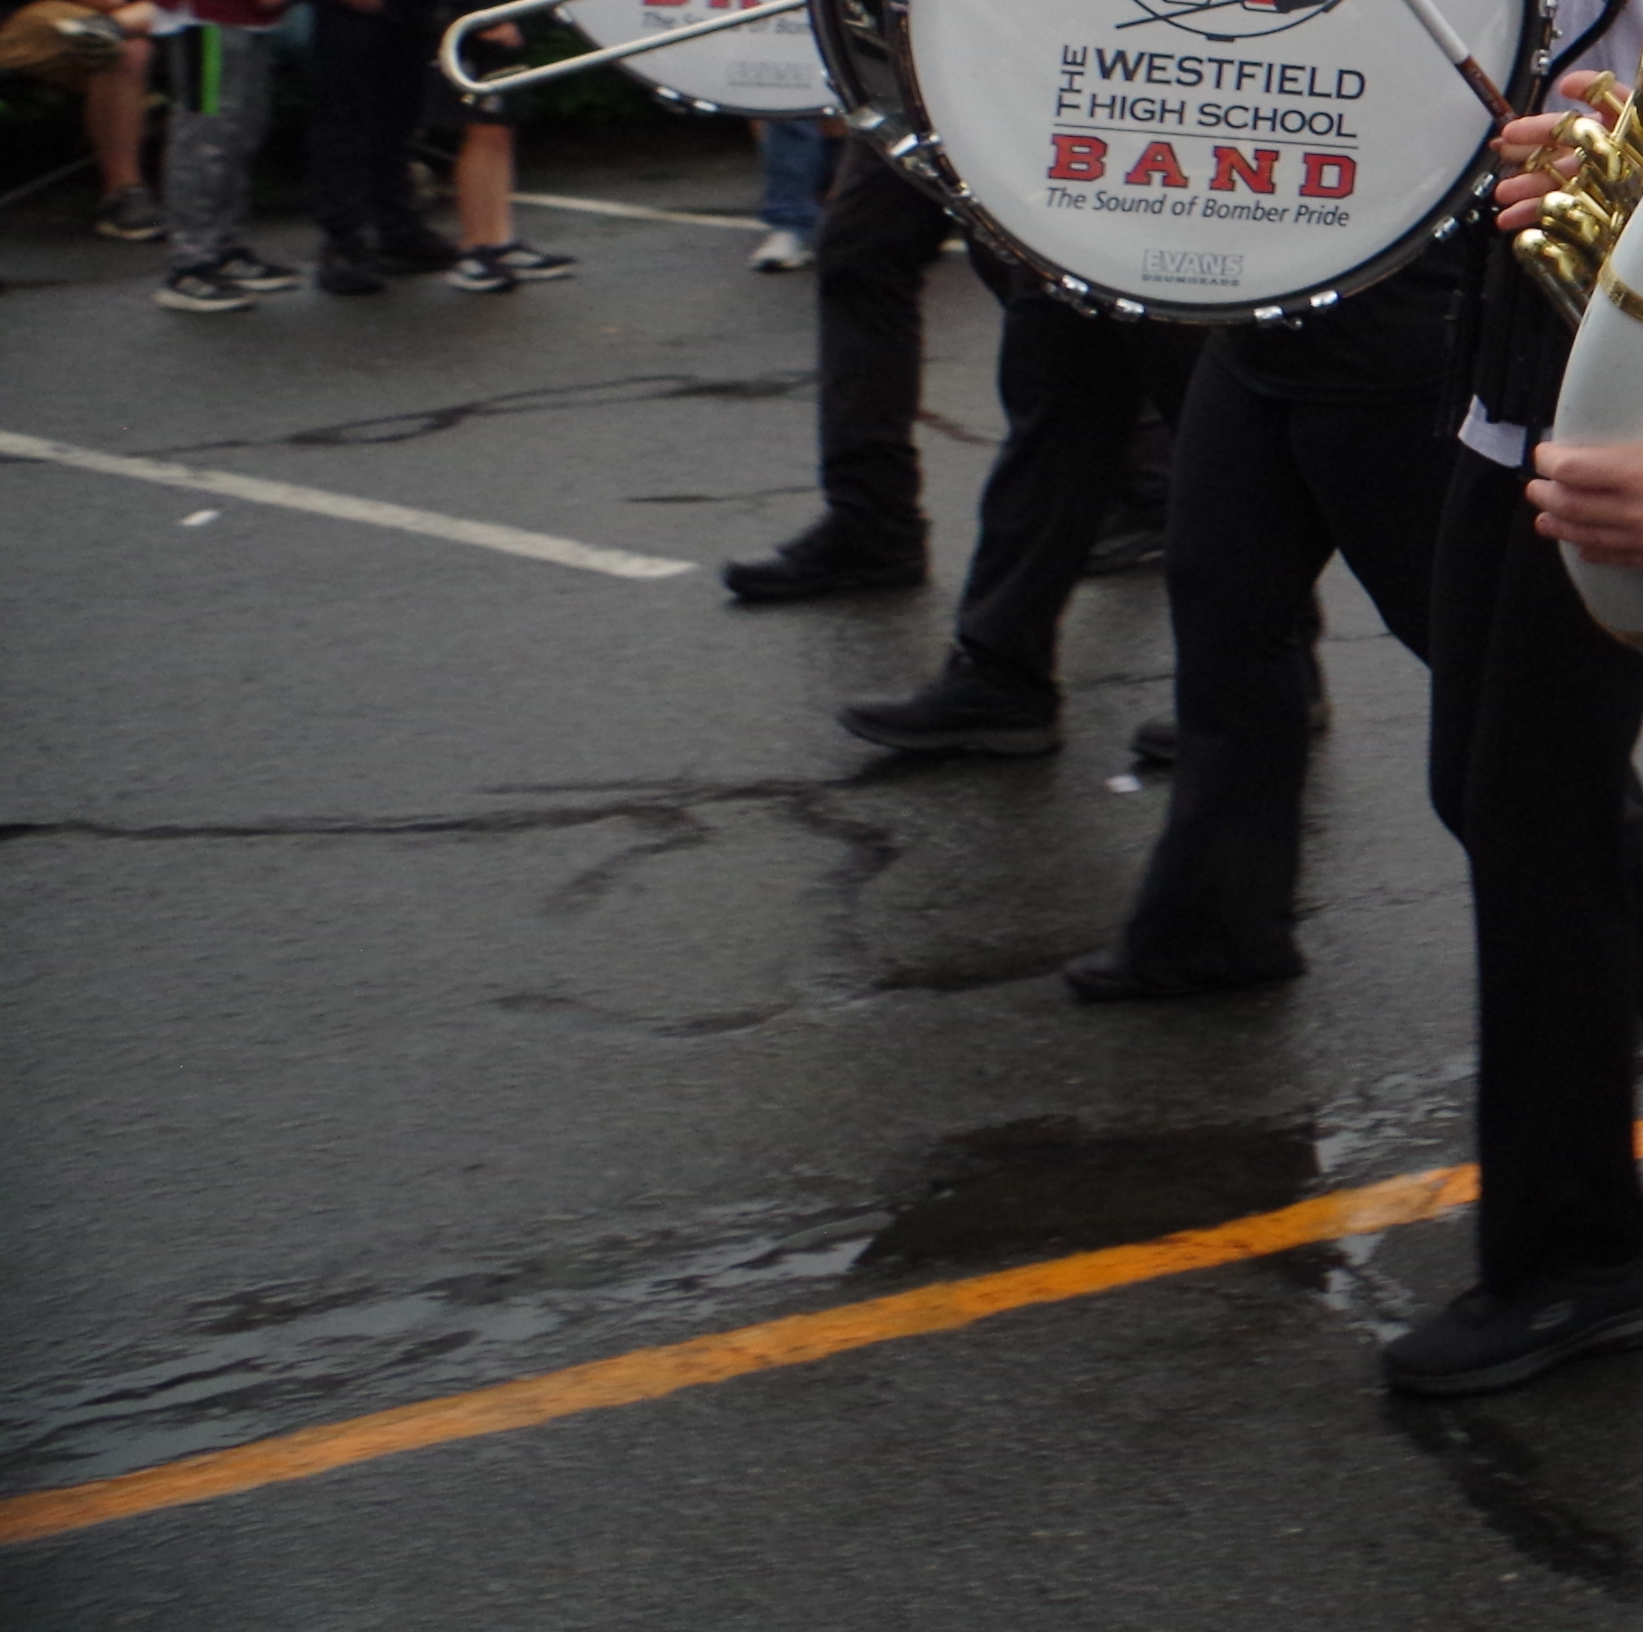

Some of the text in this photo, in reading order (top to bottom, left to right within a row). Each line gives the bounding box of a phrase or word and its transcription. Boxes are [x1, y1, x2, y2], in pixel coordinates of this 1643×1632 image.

[1055, 44, 1088, 116] THE
[1095, 47, 1367, 100] WESTFIELD
[1089, 93, 1359, 139] HIGH SCHOOL
[1046, 133, 1358, 199] BAND
[1046, 187, 1350, 228] The Sound of Bomber Pride
[1142, 249, 1245, 277] EVANS
